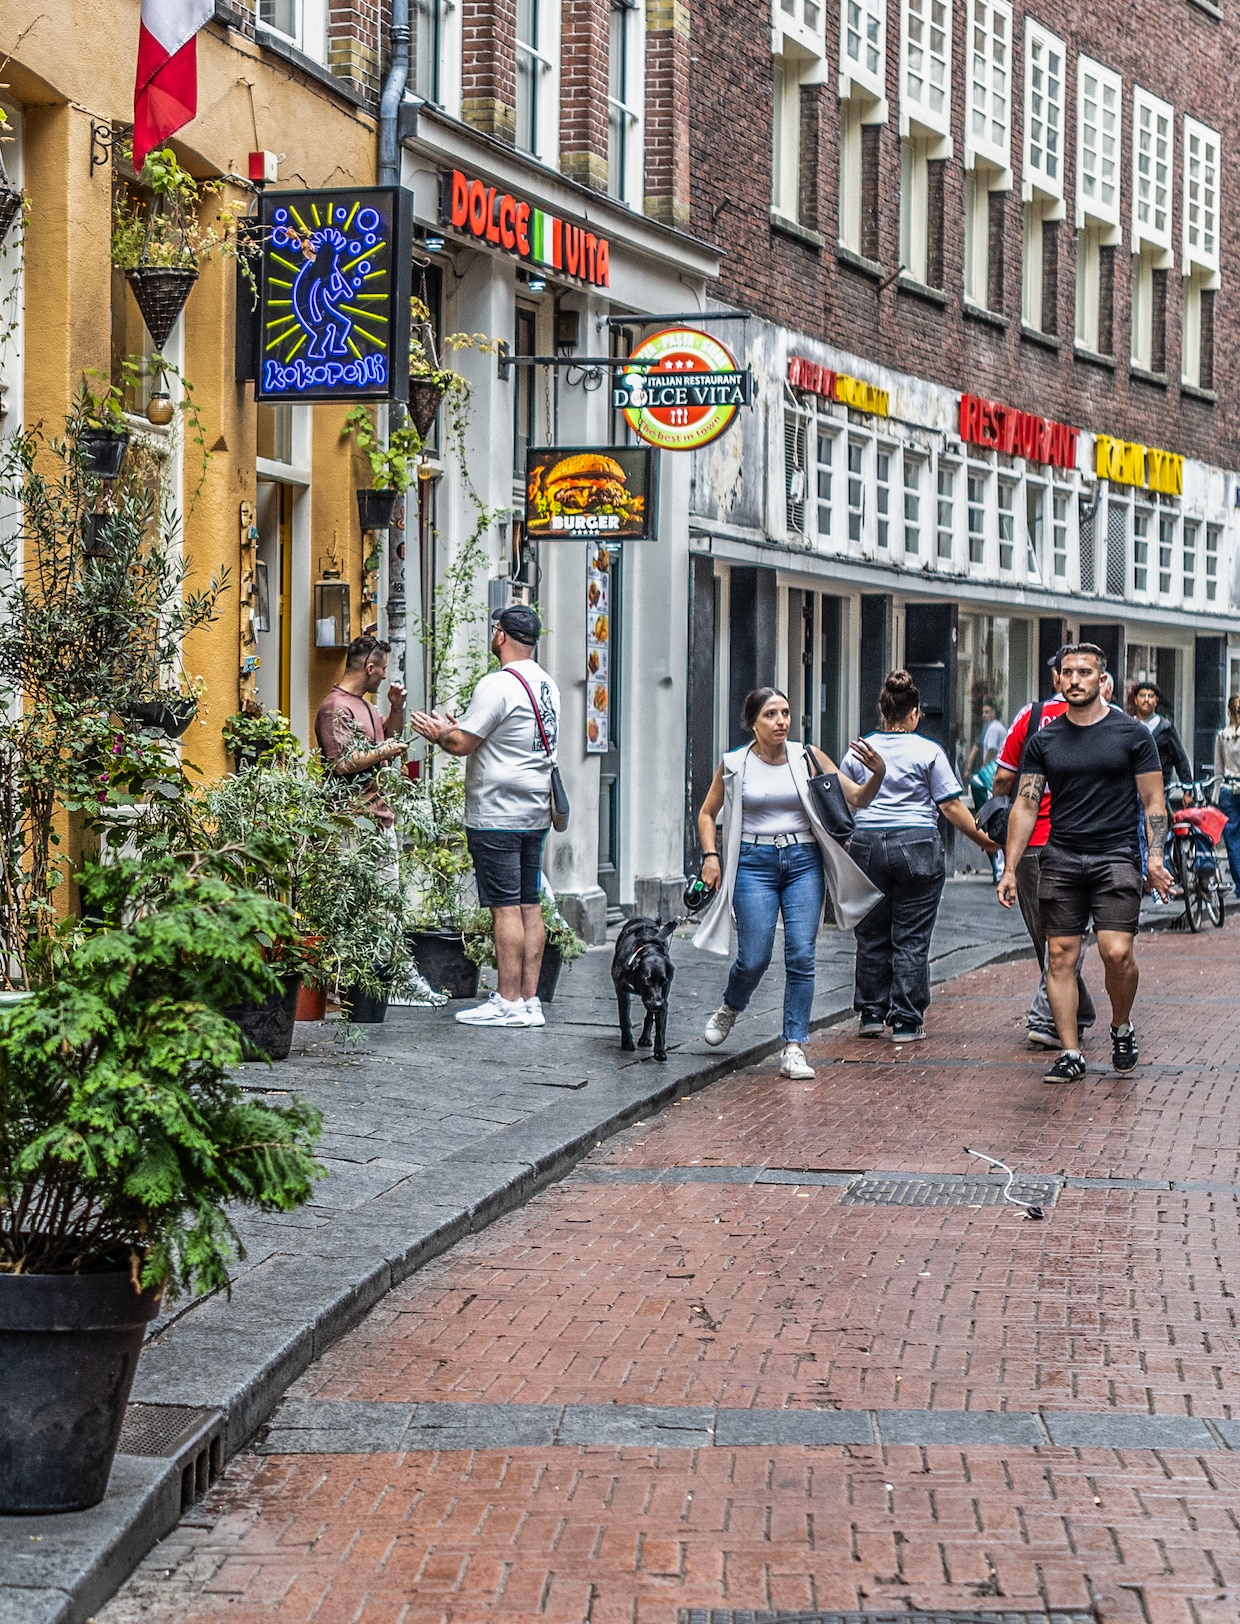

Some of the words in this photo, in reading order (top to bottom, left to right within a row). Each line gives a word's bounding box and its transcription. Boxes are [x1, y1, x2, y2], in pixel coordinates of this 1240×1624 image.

[451, 169, 530, 256] DOLCE
[565, 222, 609, 288] VITA
[661, 333, 695, 348] PASTA
[647, 375, 683, 387] ITALIAN
[684, 375, 742, 386] RESTAURANT
[693, 385, 745, 405] VITA
[640, 418, 656, 437] The
[657, 431, 680, 443] best
[696, 416, 722, 436] town
[961, 393, 1080, 471] RESTAURANT
[551, 514, 620, 530] BURGER
